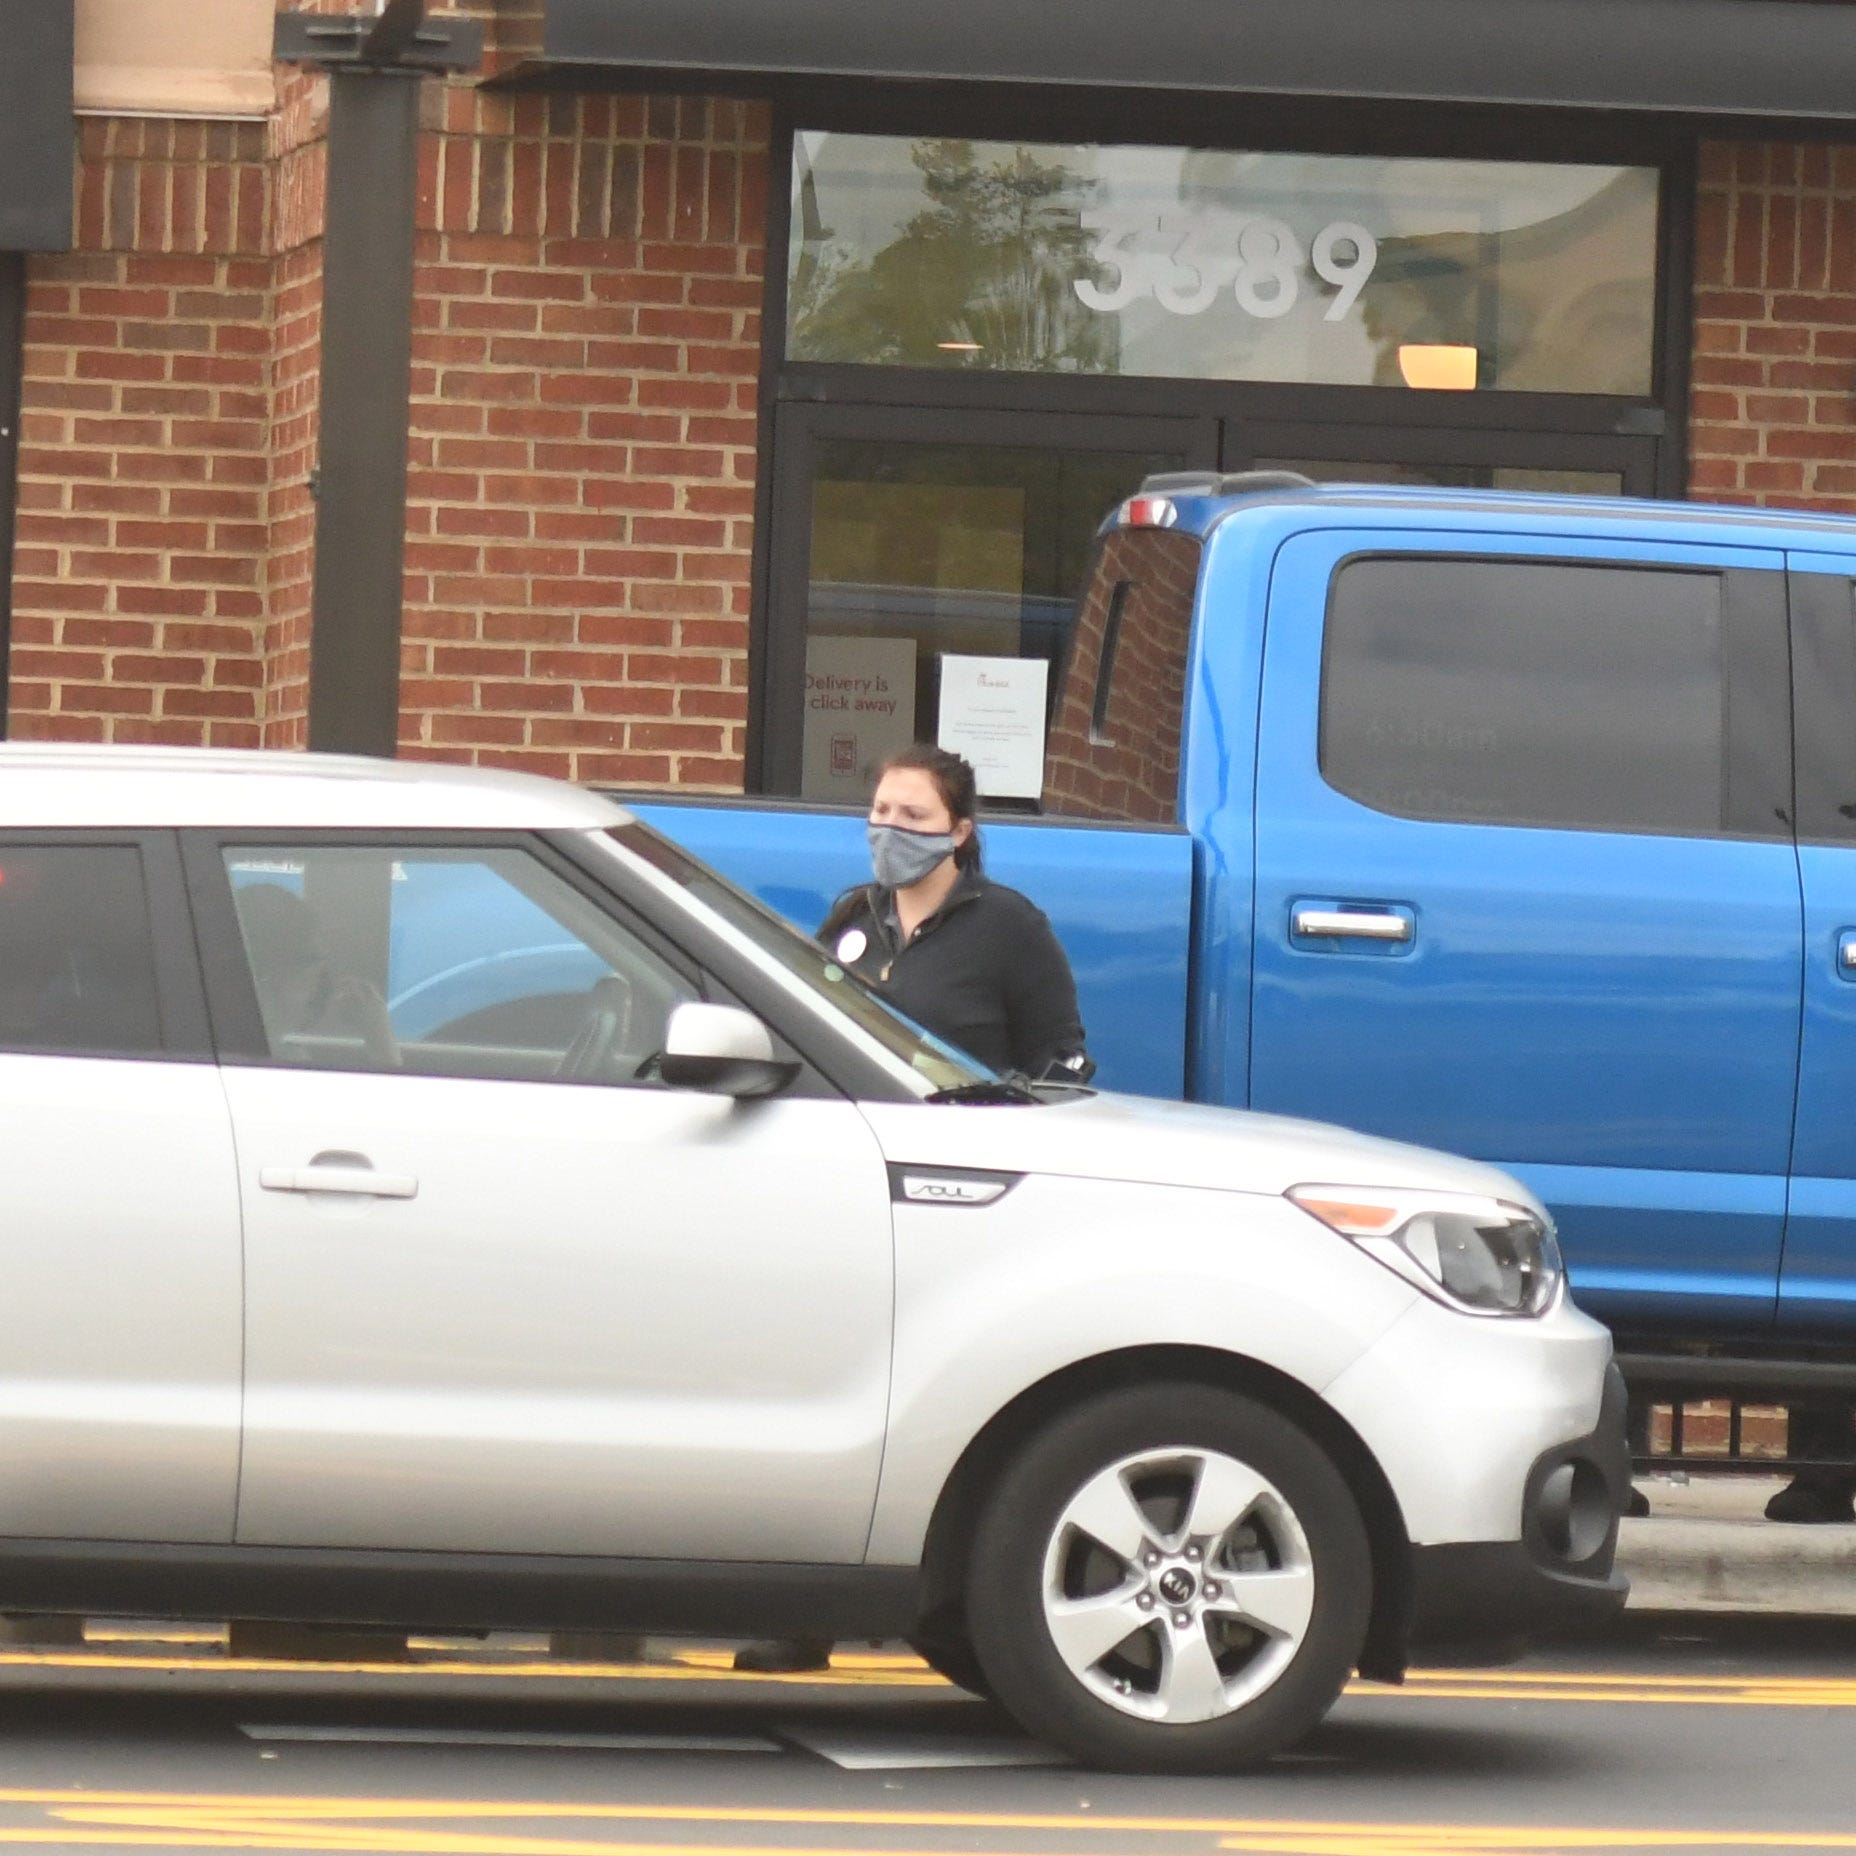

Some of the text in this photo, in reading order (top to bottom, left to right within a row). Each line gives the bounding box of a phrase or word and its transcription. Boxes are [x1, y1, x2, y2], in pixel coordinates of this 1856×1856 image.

[1074, 210, 1378, 322] 3389
[805, 674, 889, 695] Delivery is
[810, 694, 897, 717] click away
